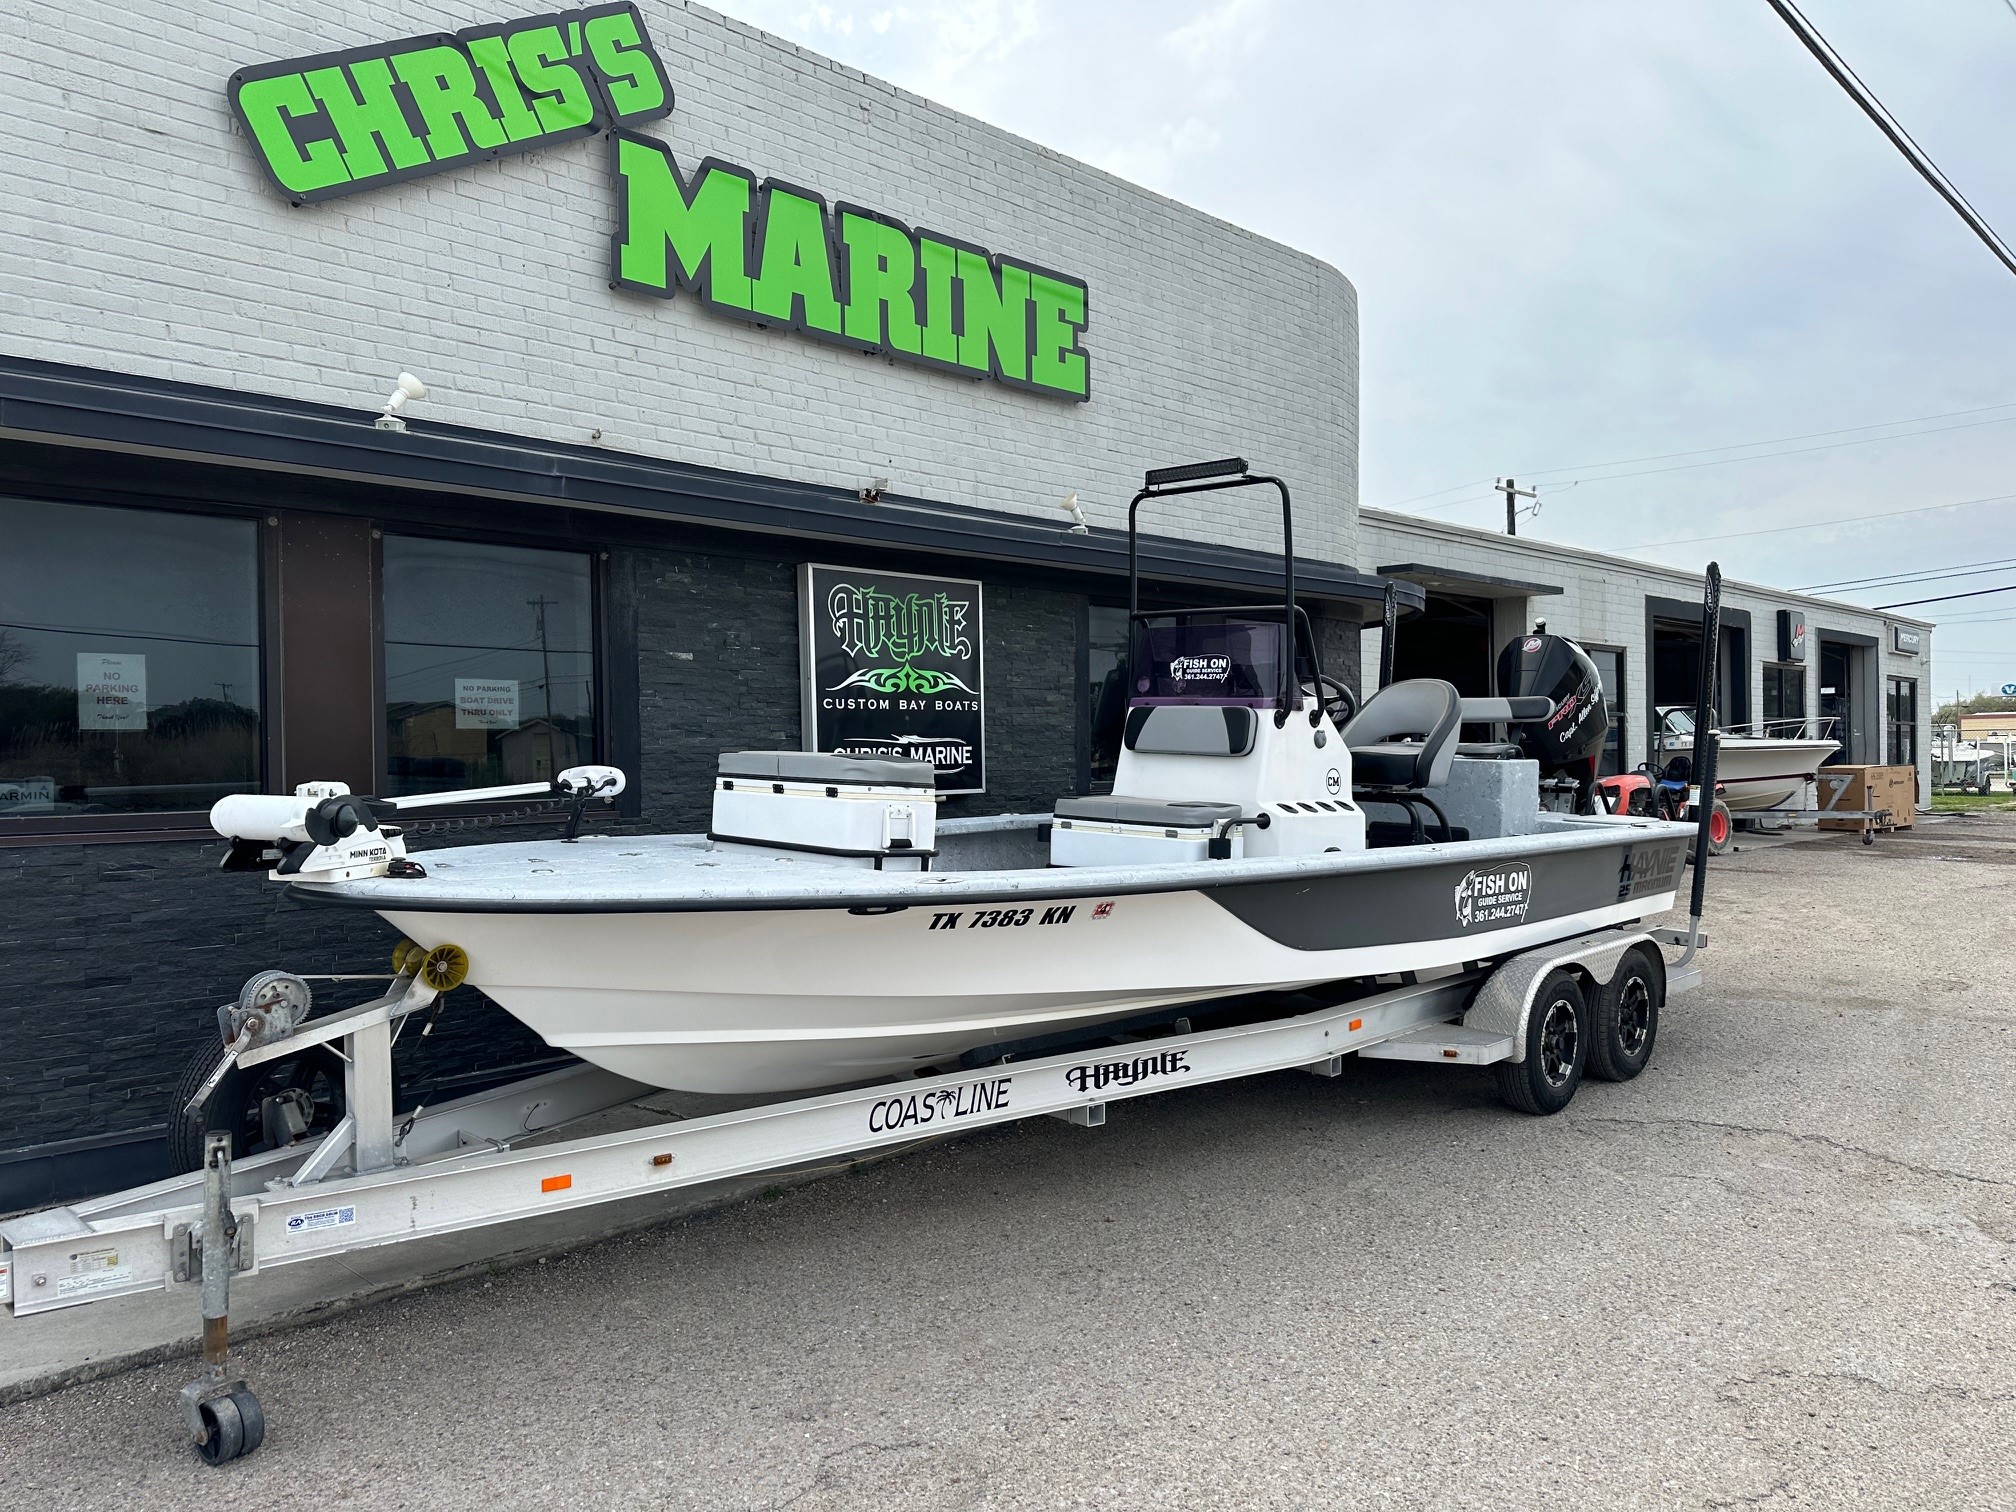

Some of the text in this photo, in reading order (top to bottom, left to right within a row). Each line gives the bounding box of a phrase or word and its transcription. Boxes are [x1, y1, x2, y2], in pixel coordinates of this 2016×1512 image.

[238, 11, 665, 192] CHRIS'S
[619, 138, 1088, 395] MARINE
[1184, 659, 1227, 668] FISH ON
[103, 671, 121, 681] NO
[85, 683, 139, 693] PARKING
[96, 696, 129, 705] HERE
[823, 698, 979, 711] CUSTOM BAY BOATS
[1559, 721, 1578, 743] Capt.
[910, 746, 973, 765] MARINE
[1328, 777, 1339, 786] CM
[350, 847, 386, 858] MINN KOTA
[1473, 870, 1528, 897] FISH ON
[1477, 891, 1523, 907] GUIDE SERVICE
[928, 912, 964, 930] TX
[967, 908, 1035, 929] 7383
[1038, 905, 1078, 925] KN
[1474, 903, 1524, 923] 361.244.2747
